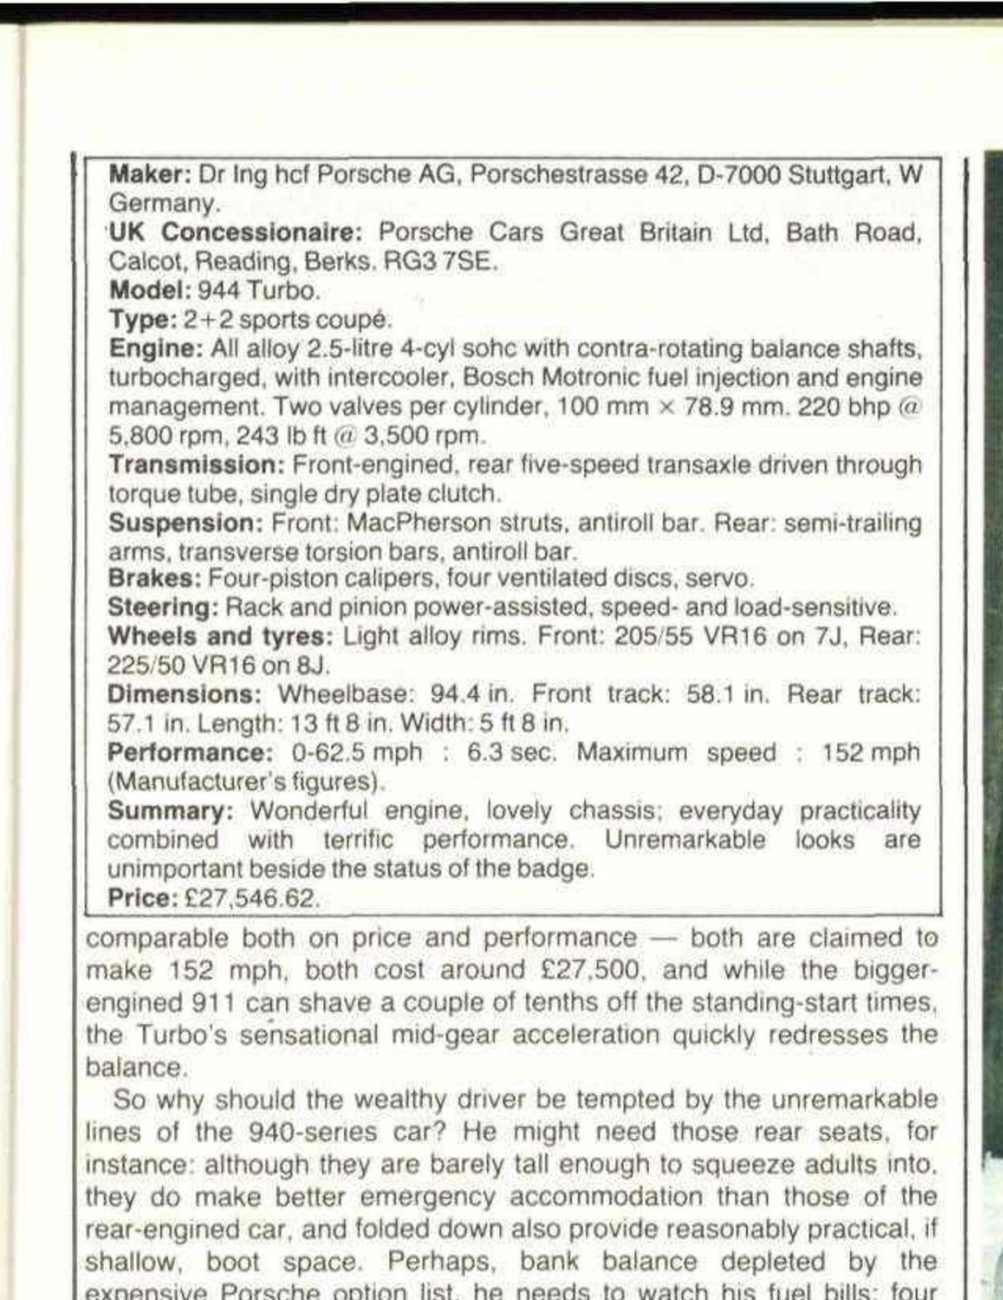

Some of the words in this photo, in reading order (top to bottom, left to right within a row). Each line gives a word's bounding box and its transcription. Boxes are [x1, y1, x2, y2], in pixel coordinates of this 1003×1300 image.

[110, 163, 191, 185] Maker:
[199, 163, 226, 185] Dr
[234, 164, 268, 190] Ing
[318, 163, 412, 185] Porsche
[419, 163, 462, 187] AG,
[471, 163, 649, 185] Porschestrasse
[655, 164, 690, 187] 42,
[698, 164, 782, 186] D-7000
[789, 164, 891, 191] Stuttgart,
[899, 164, 924, 185] W
[109, 192, 221, 219] Germany.
[109, 221, 146, 243] UK
[161, 221, 362, 243] Concessionaire:
[380, 221, 474, 243] Porsche
[490, 221, 544, 243] Cars
[560, 221, 625, 243] Great
[640, 221, 713, 243] Britain
[729, 222, 770, 245] Ltd,
[787, 222, 839, 243] Bath
[856, 222, 922, 245] Road,
[109, 250, 189, 274] Calcot,
[196, 250, 298, 277] Reading,
[305, 250, 377, 272] Berks.
[385, 250, 438, 272] RG3
[443, 249, 498, 272] 7SE.
[110, 279, 192, 301] Model:
[198, 280, 241, 301] 944
[246, 279, 321, 301] Turbo.
[109, 308, 177, 335] Type:
[184, 309, 234, 330] 2+2
[240, 311, 311, 334] sports
[110, 337, 203, 364] Engine:
[211, 337, 239, 358] All
[247, 338, 301, 365] alloy
[308, 338, 394, 359] 2.5-litre
[401, 338, 455, 364] 4-cyl
[463, 337, 518, 359] sohc
[524, 338, 570, 359] with
[578, 338, 744, 364] contra-rotating
[751, 339, 841, 360] balance
[848, 337, 922, 361] shafts,
[108, 799, 233, 826] Summary:
[250, 799, 368, 821] Wonderful
[386, 800, 469, 826] engine,
[488, 800, 553, 826] lovely
[570, 799, 663, 822] chassis;
[680, 800, 784, 826] everyday
[801, 800, 922, 826] practicality
[108, 829, 219, 850] combined
[248, 830, 294, 850] with
[324, 829, 394, 851] terrific
[424, 828, 575, 854] performance.
[606, 829, 766, 850] Unremarkable
[796, 829, 856, 851] looks
[885, 833, 922, 850] are
[108, 887, 178, 909] Price:
[185, 888, 320, 911] £27,546.62.
[87, 960, 153, 981] make
[171, 959, 214, 982] 152
[230, 959, 289, 986] mph,
[306, 959, 359, 981] both
[375, 960, 425, 981] cost
[441, 958, 526, 981] around
[542, 958, 646, 982] £27,500,
[663, 959, 708, 981] and
[724, 959, 786, 981] while
[801, 959, 838, 981] the
[855, 959, 938, 986] bigger-
[114, 1088, 147, 1111] So
[157, 1089, 205, 1116] why
[216, 1088, 296, 1112] should
[307, 1089, 344, 1111] the
[355, 1088, 448, 1116] wealthy
[458, 1089, 527, 1110] driver
[537, 1088, 567, 1110] be
[577, 1089, 675, 1115] tempted
[686, 1089, 714, 1116] by
[724, 1088, 762, 1111] the
[773, 1088, 939, 1111] unremarkable
